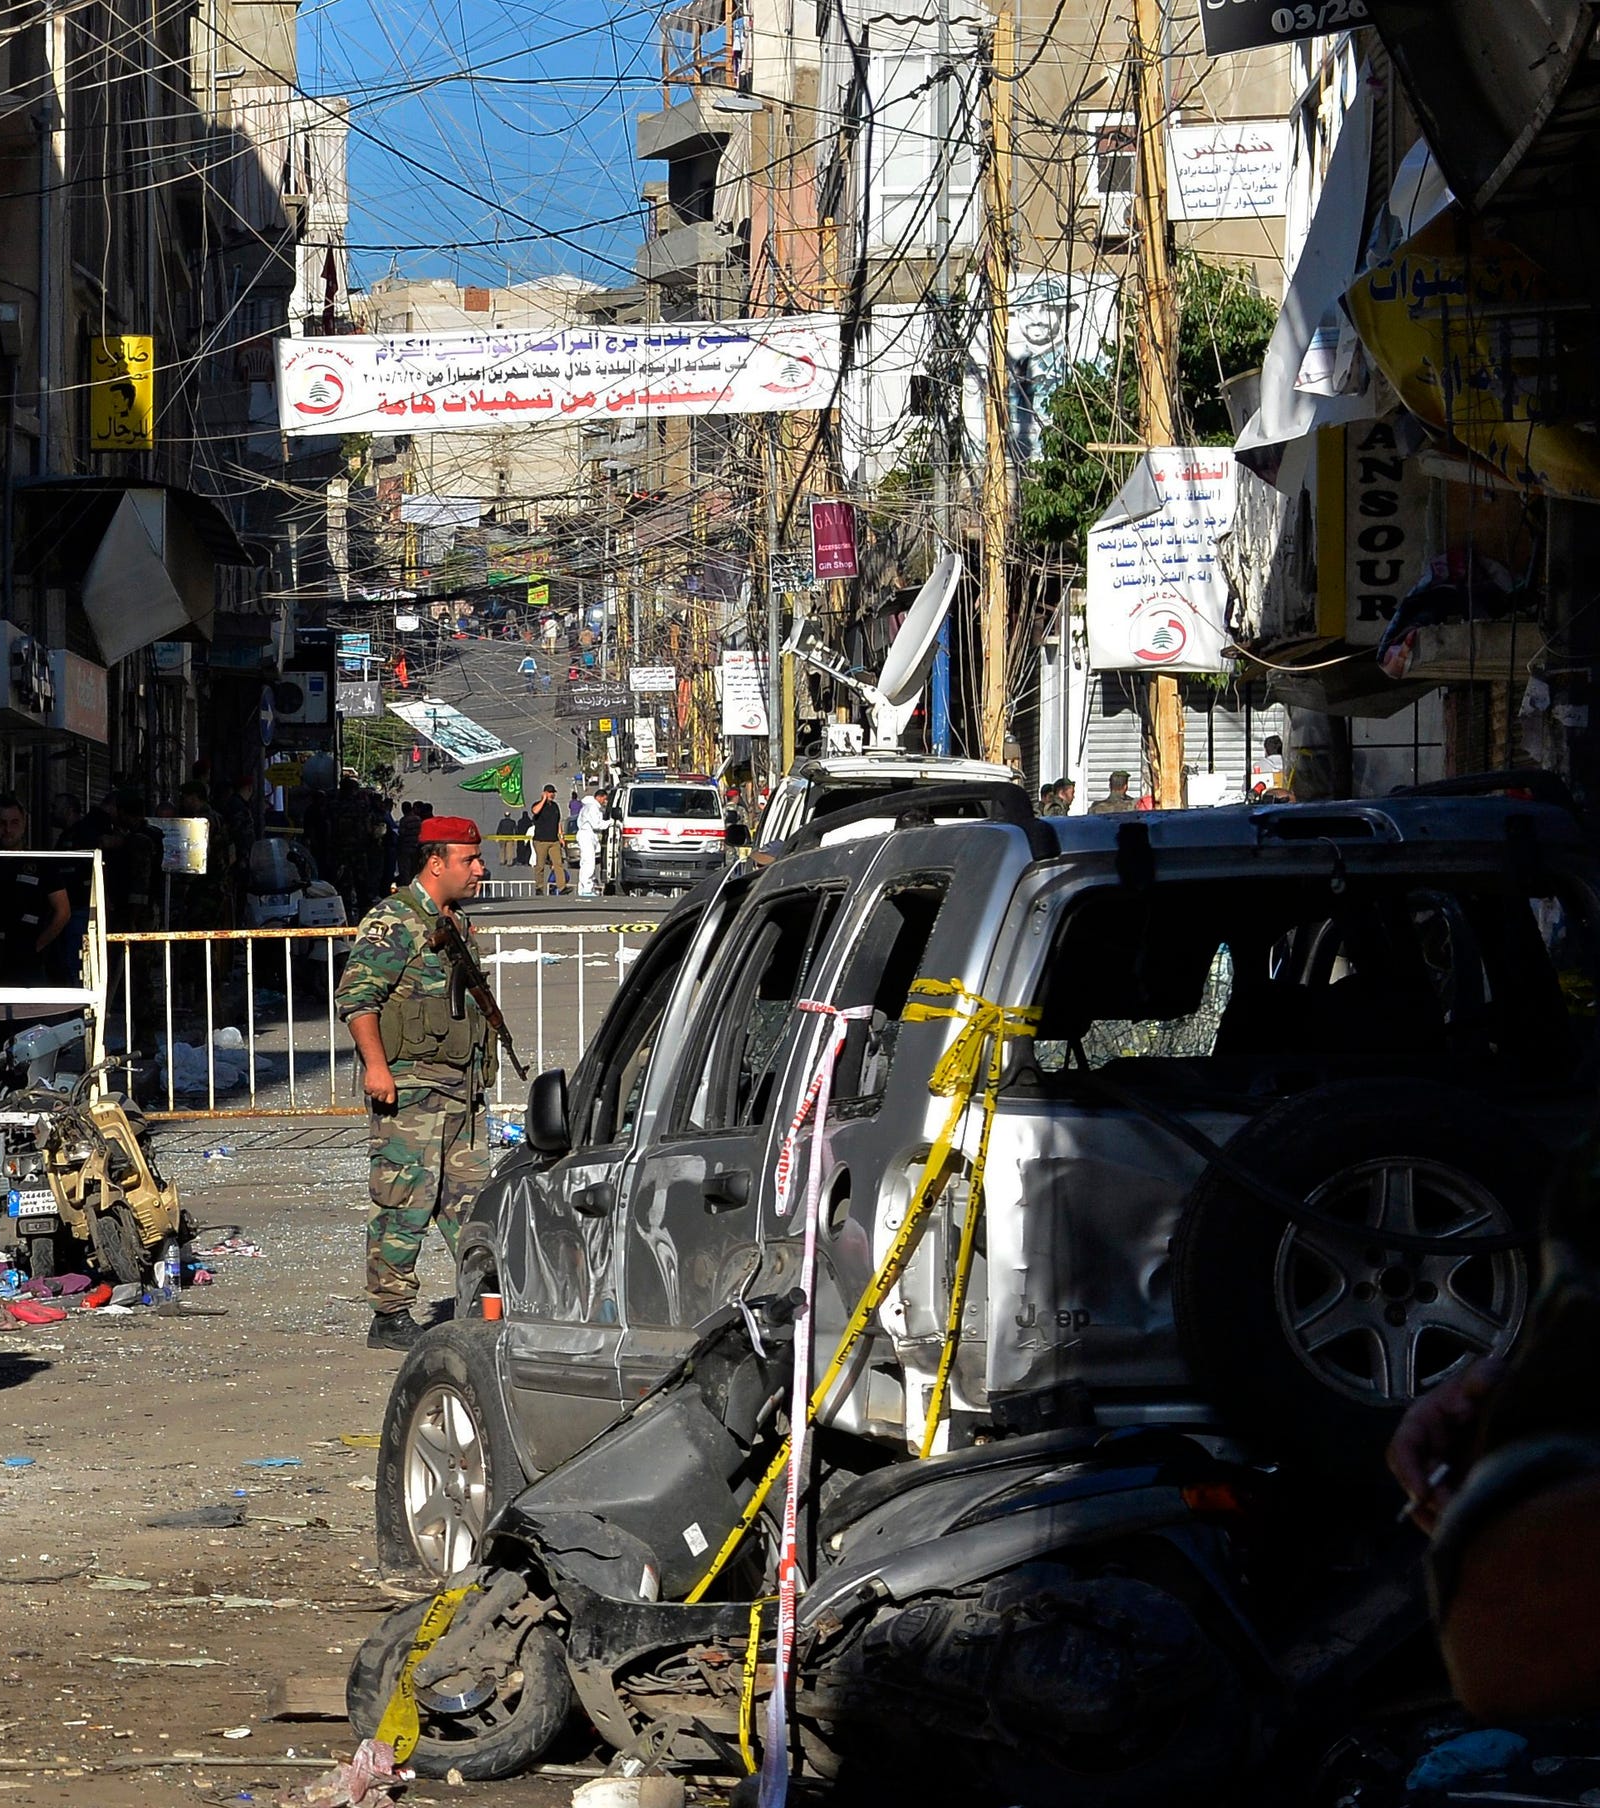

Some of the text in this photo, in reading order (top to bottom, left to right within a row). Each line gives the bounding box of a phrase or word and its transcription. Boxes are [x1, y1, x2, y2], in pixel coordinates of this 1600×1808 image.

[605, 332, 639, 354] برج
[644, 330, 691, 350] بلدية
[375, 338, 431, 366] الكرام
[489, 362, 530, 384] شهرين
[532, 362, 561, 380] مهلة
[564, 360, 592, 381] خلال
[595, 358, 635, 380] البلدية
[639, 357, 681, 378] الرسوم
[426, 370, 444, 387] من
[376, 379, 736, 418] مستفيدين من تسهيلات هامة
[1097, 538, 1138, 553] منازلهم
[818, 560, 853, 570] Gift Shop
